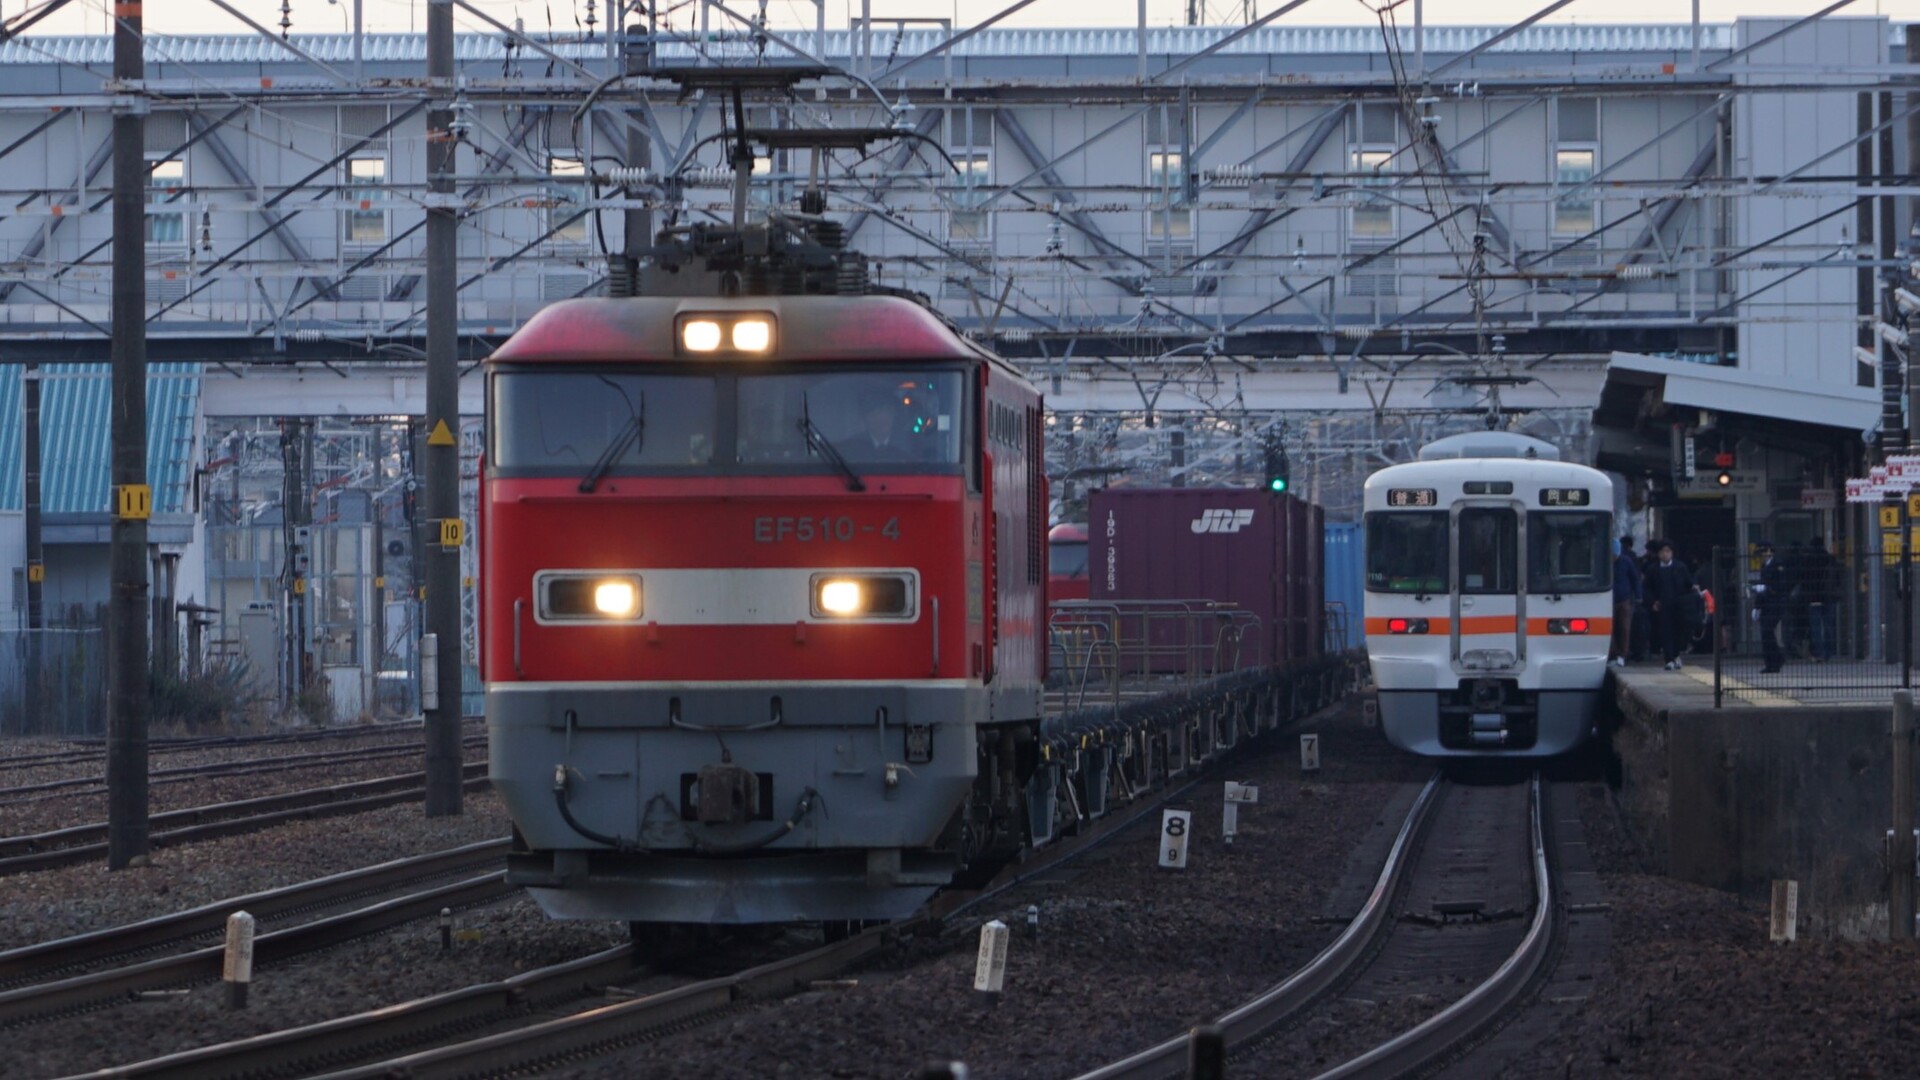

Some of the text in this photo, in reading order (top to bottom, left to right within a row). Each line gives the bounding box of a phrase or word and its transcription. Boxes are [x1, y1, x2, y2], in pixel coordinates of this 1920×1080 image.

[126, 491, 144, 512] 11
[754, 516, 902, 543] EF510-4
[1190, 508, 1255, 534] JRF
[444, 524, 458, 540] 10
[1302, 737, 1316, 751] 7
[1165, 816, 1185, 837] 8
[1168, 849, 1178, 862] 9
